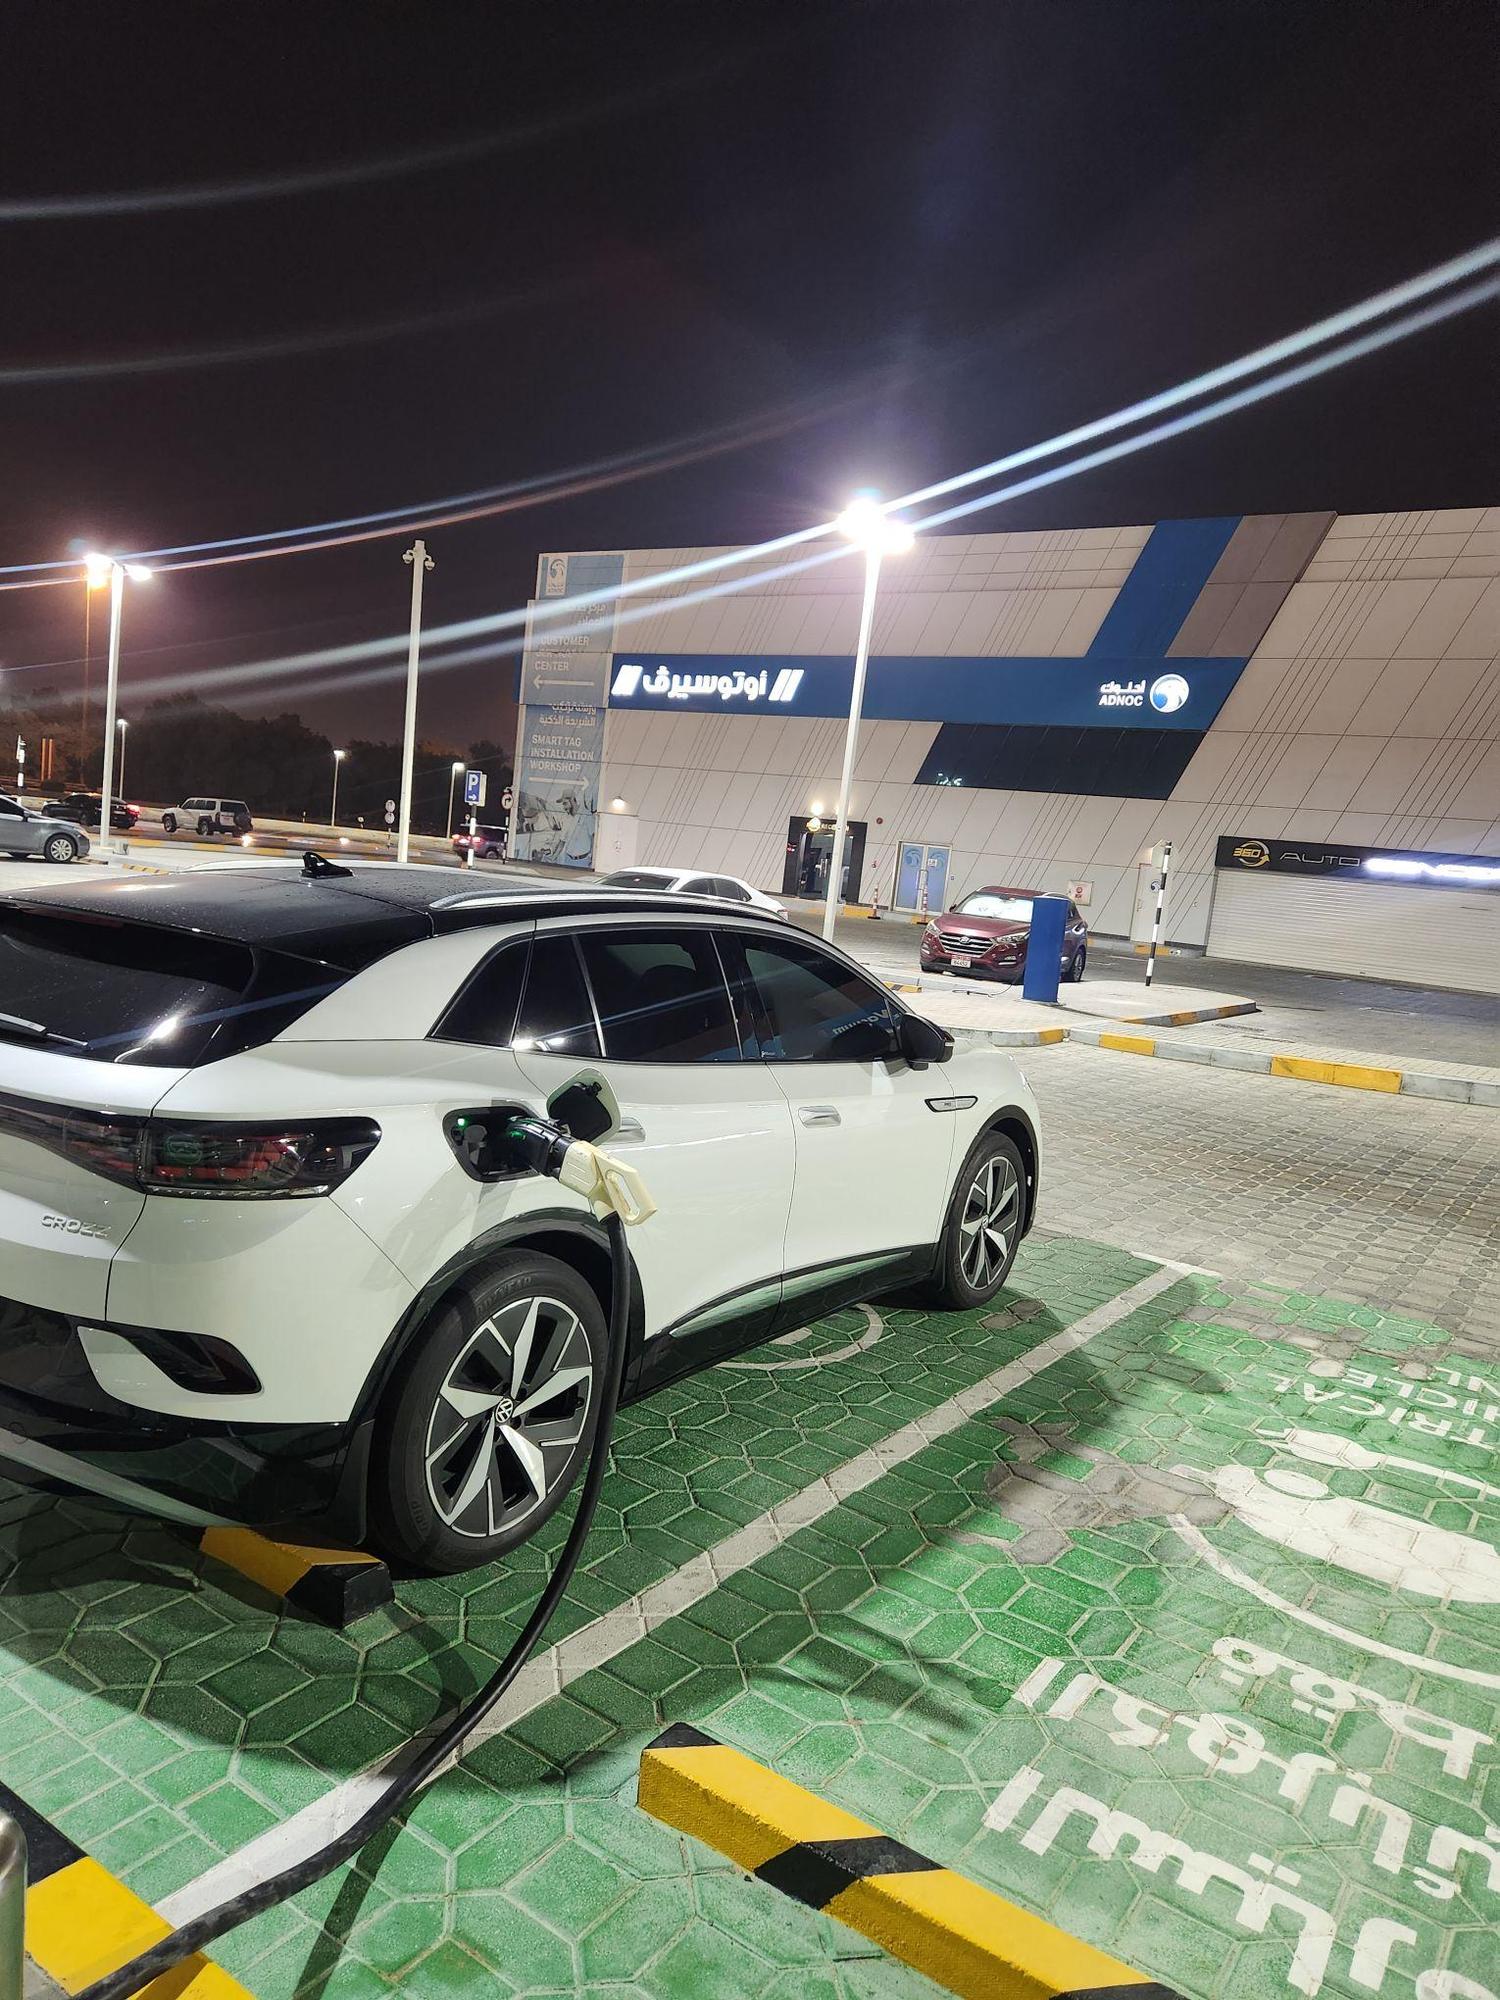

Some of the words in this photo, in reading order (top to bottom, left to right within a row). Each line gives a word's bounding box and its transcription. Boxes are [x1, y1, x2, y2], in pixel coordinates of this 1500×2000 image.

[540, 635, 590, 648] CUSTOMER
[535, 660, 570, 672] CENTER
[1098, 694, 1144, 707] ADNOC
[532, 734, 563, 746] SMART
[564, 736, 582, 747] TAG
[530, 747, 594, 761] INSTALLATION
[529, 759, 582, 773] WORKSHOP
[468, 773, 479, 791] P
[1233, 847, 1262, 858] 360
[1279, 852, 1361, 867] AUTO
[41, 1215, 112, 1239] CROZZ
[1212, 1636, 1494, 1780] فقط
